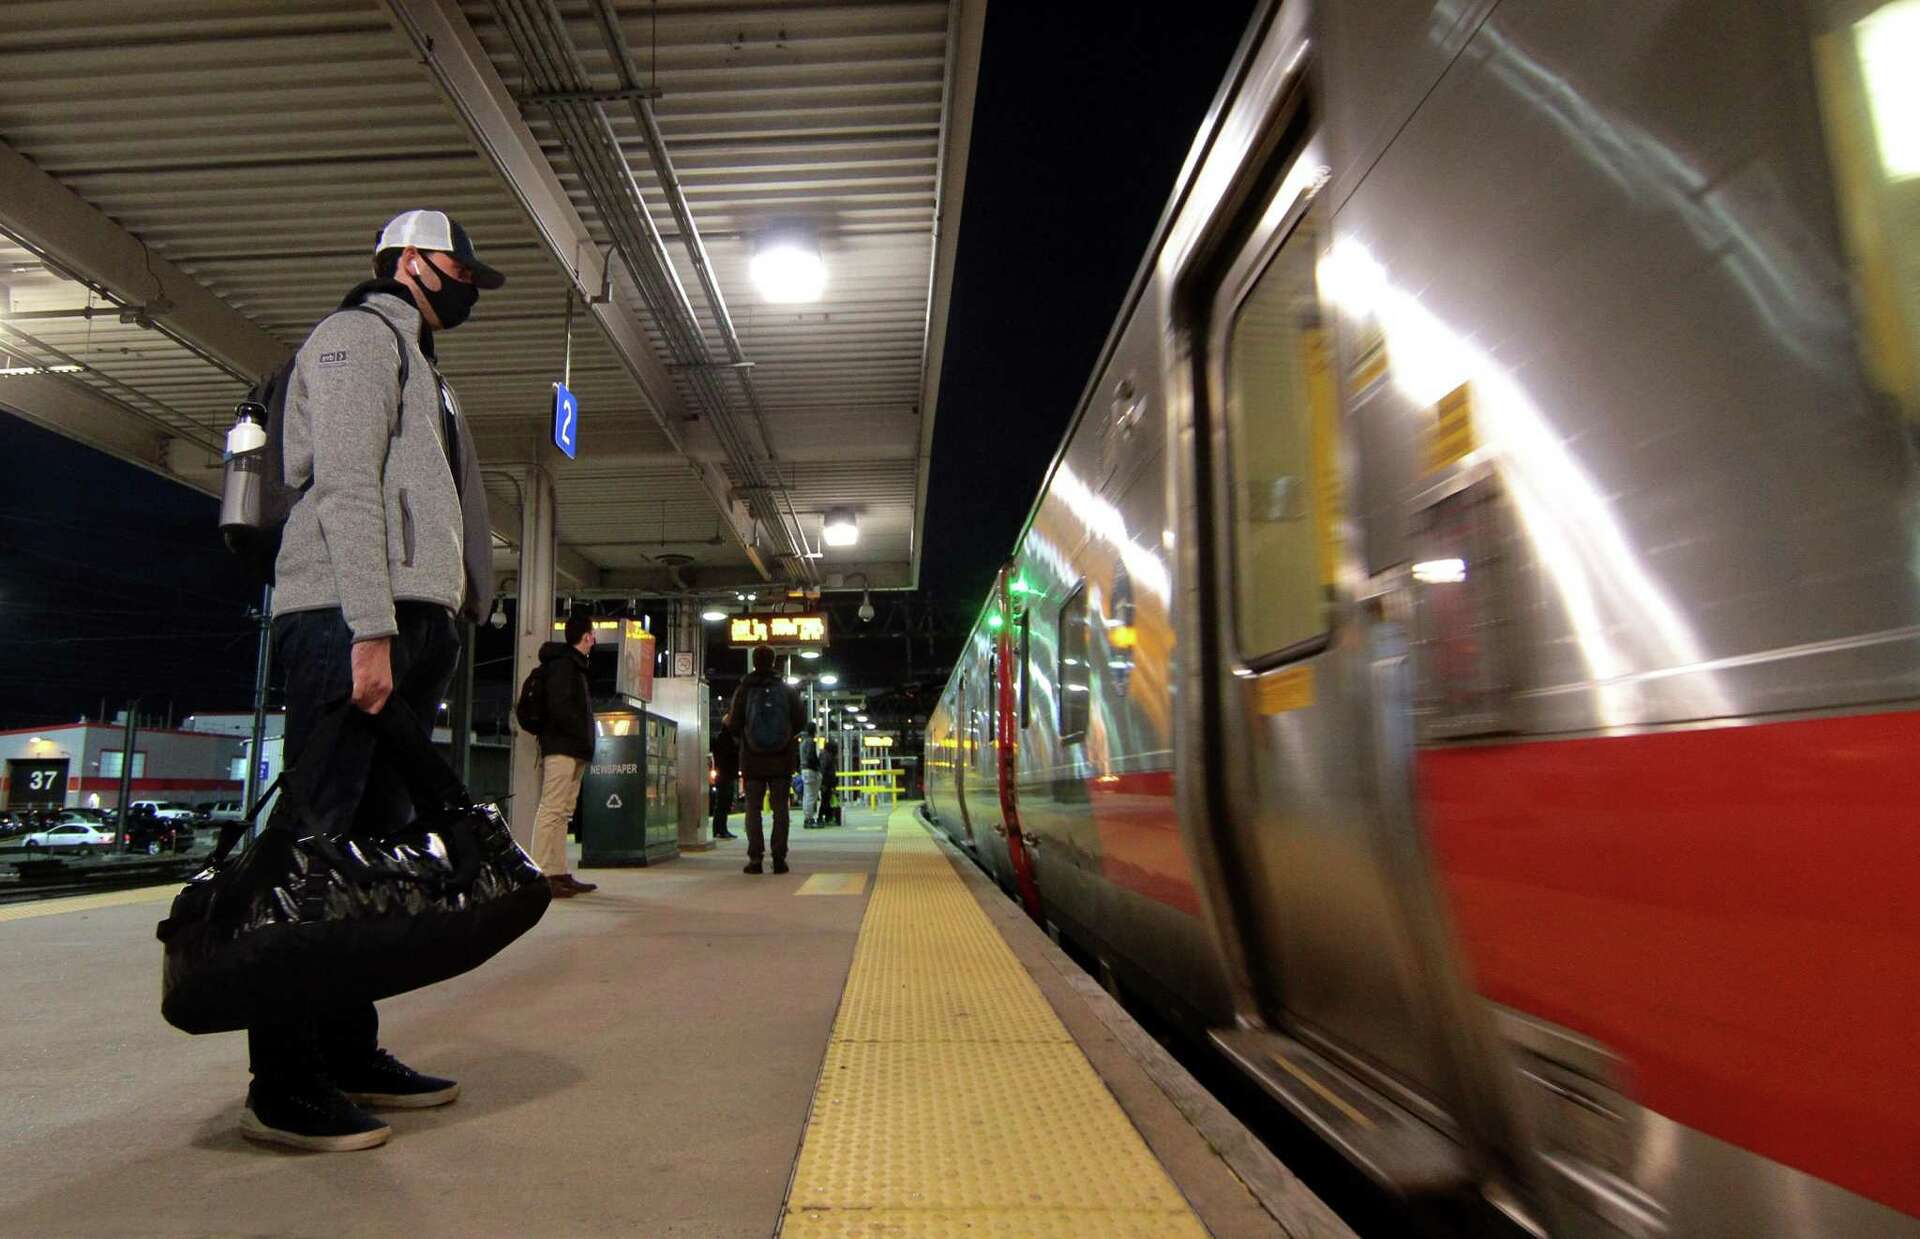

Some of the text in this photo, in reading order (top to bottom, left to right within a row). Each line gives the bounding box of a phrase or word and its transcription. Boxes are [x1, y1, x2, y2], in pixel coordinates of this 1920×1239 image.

[561, 399, 572, 446] 2
[590, 762, 638, 775] NEWSPAPER
[30, 770, 57, 790] 37
